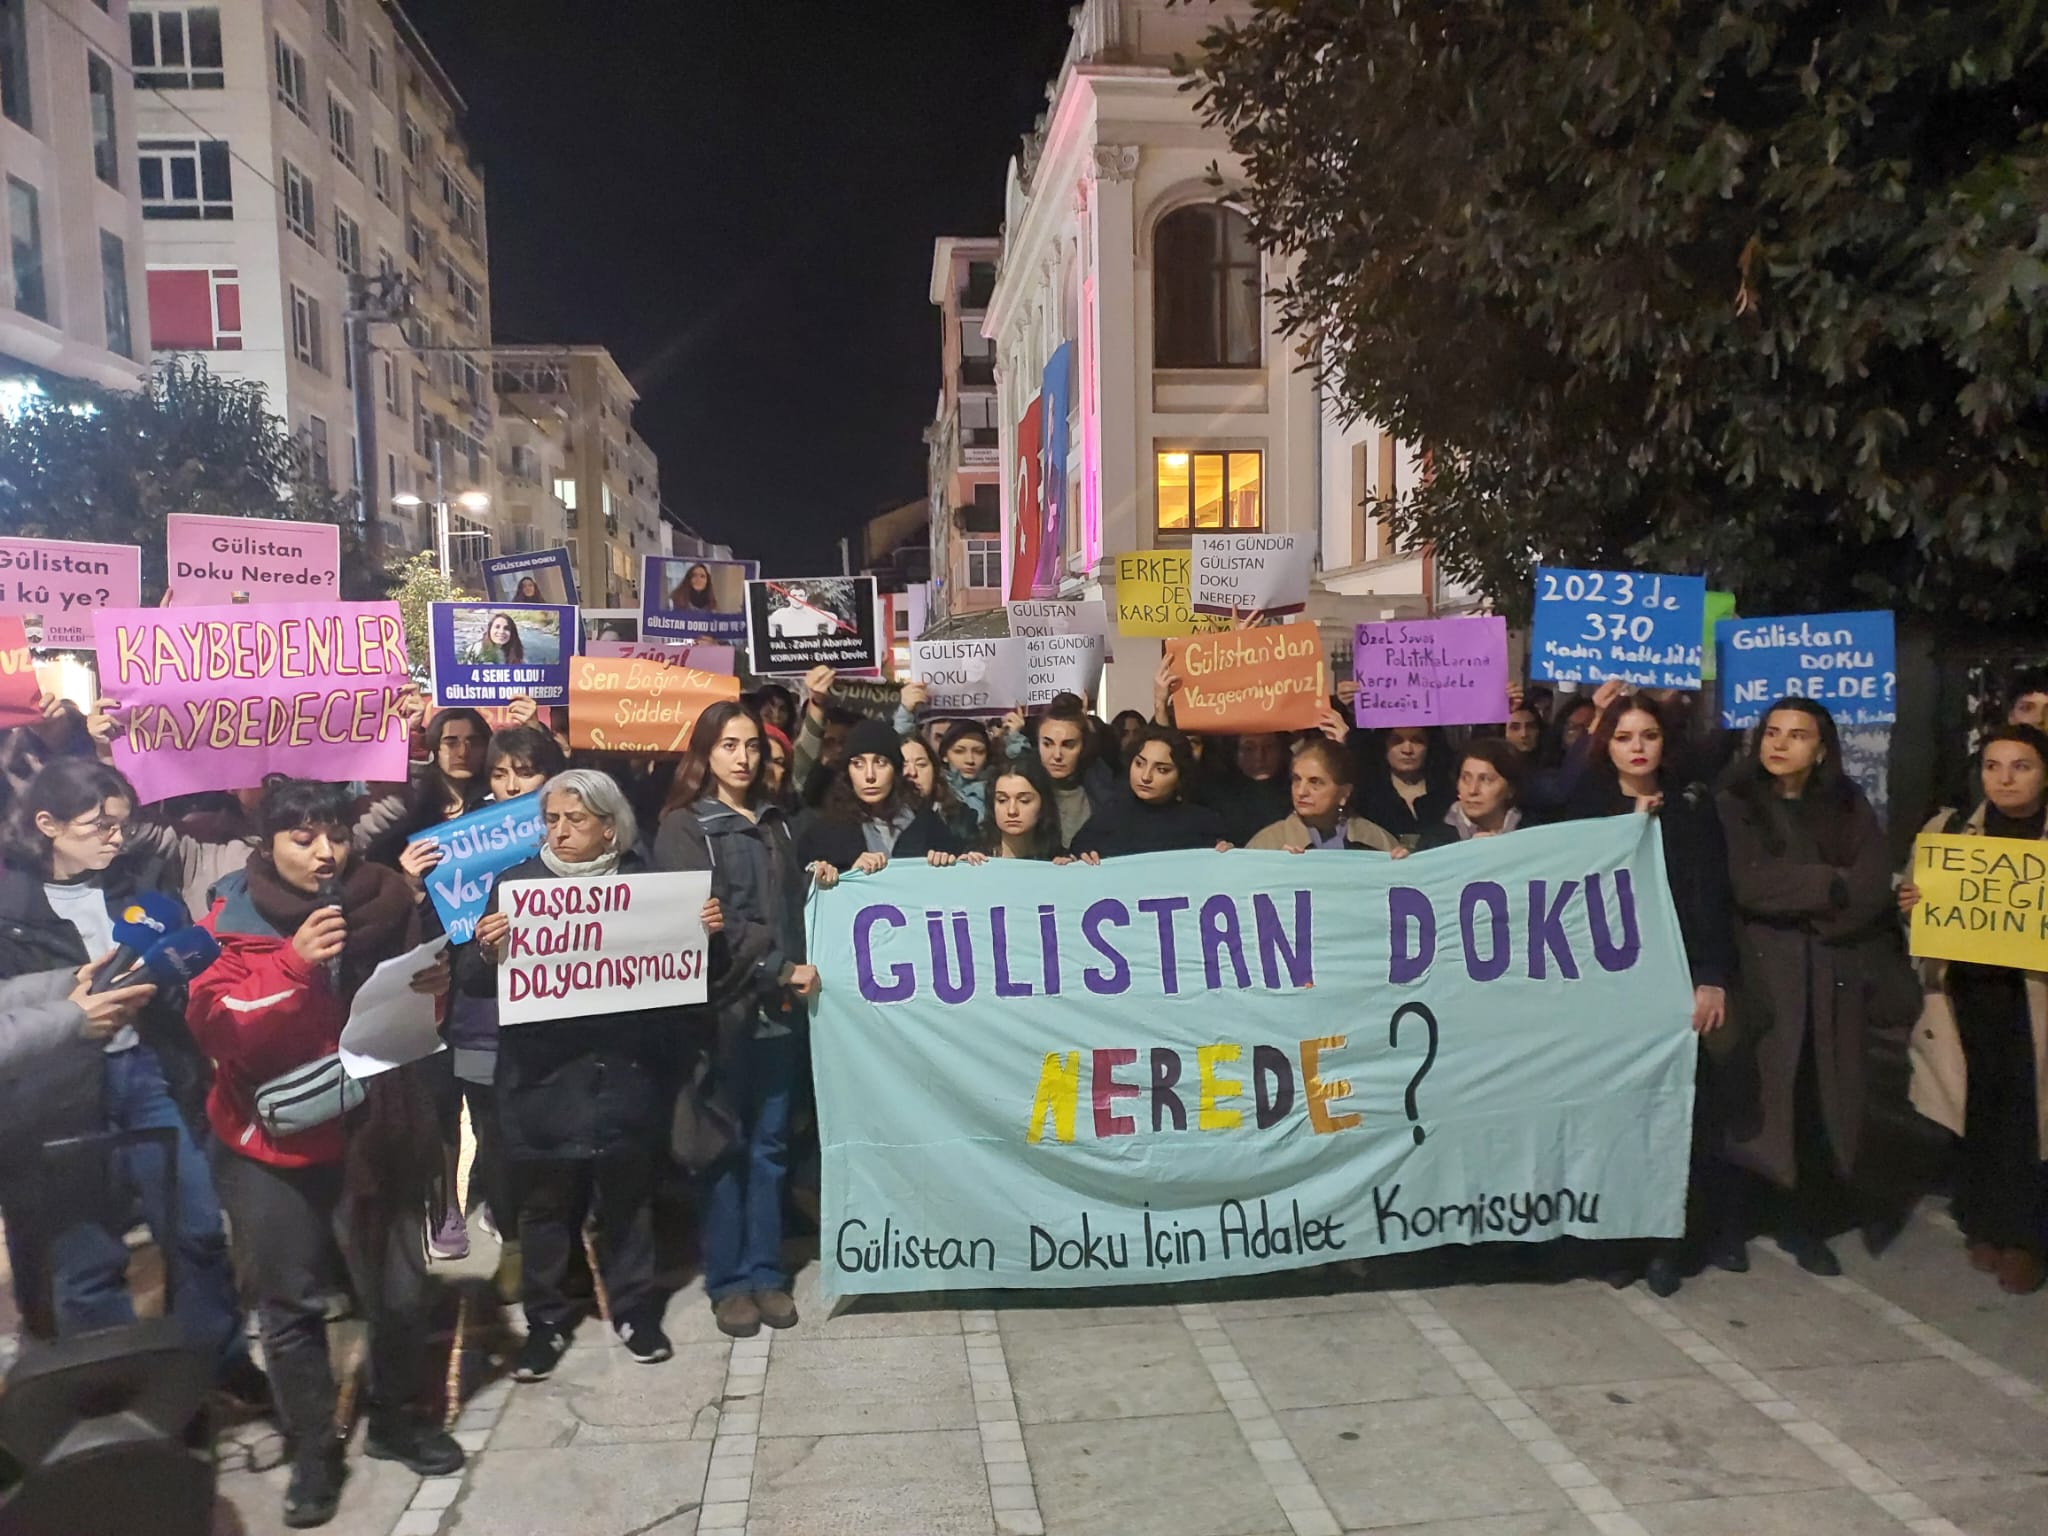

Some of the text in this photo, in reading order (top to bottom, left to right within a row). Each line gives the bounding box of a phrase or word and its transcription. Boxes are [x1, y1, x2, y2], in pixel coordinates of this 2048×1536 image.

[211, 537, 303, 559] Gülistan
[1202, 536, 1294, 551] 1461 GÜNDÜR
[531, 555, 557, 566] DOKU
[1200, 555, 1265, 570] GÜLİSTAN
[177, 562, 335, 586] Doku Nerede?
[1121, 558, 1190, 585] ERKEK
[1200, 574, 1239, 588] DOKU
[60, 588, 110, 611] ye?
[1200, 591, 1256, 606] NEREDE?
[1013, 604, 1076, 617] GÜLİSTAN
[687, 620, 709, 632] DOKU
[1016, 626, 1054, 637] DOKU
[1580, 613, 1655, 643] 370
[1027, 637, 1095, 652] 461 GÜNDÜR
[1732, 622, 1854, 650] Gülistan
[116, 615, 408, 685] KAYBEDENLER
[919, 642, 996, 660] GÜLİSTAN
[1027, 655, 1076, 668] ÜLİSTAN
[1800, 651, 1874, 670] DOKU
[471, 669, 480, 682] 4
[482, 669, 511, 683] SENE
[513, 669, 539, 682] OLDU
[578, 662, 714, 696] Sen Bağır Ki
[921, 670, 967, 686] DOKU
[1028, 675, 1055, 685] OKU
[446, 685, 496, 699] GÜLİSTAN
[128, 687, 408, 753] KAYBEDECEK
[614, 698, 684, 728] Şiddet
[1920, 846, 2046, 881] TESAD
[1925, 902, 2026, 932] KADIN
[853, 868, 1641, 1004] GÜLİSTAN DOKU
[836, 1184, 1599, 1273] Gülistan Doku İçin Adalet Komisyonu
